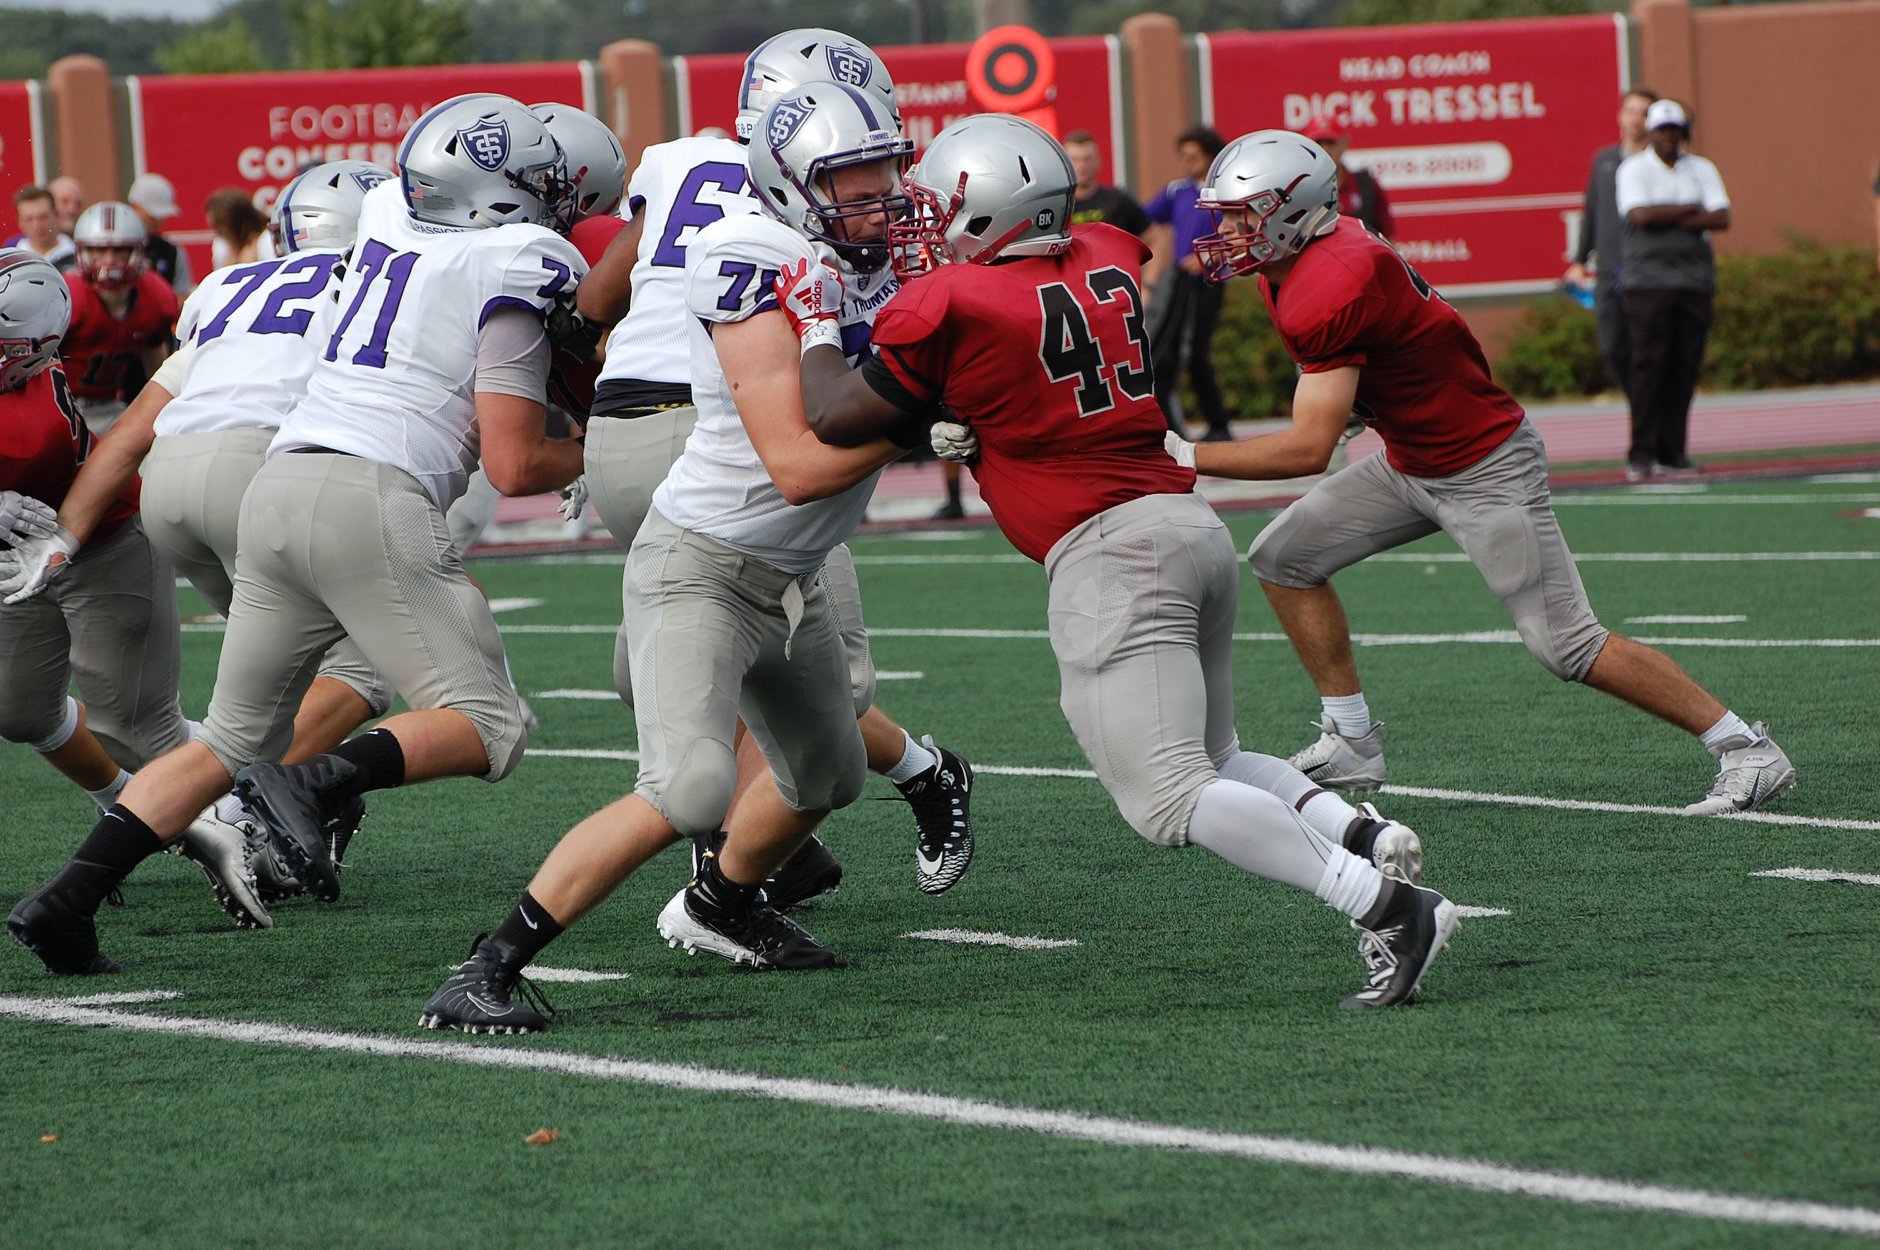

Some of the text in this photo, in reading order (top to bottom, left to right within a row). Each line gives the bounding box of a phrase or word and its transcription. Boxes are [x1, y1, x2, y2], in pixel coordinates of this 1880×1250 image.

[1339, 50, 1491, 82] HEAD COACH
[896, 80, 968, 107] STANT
[1283, 81, 1545, 131] DICK TRESSEL
[268, 102, 434, 141] FOOTBA
[1038, 212, 1053, 226] BK
[1395, 239, 1473, 264] OTBALL
[197, 252, 342, 349] 72
[324, 237, 422, 370] 71
[812, 280, 823, 315] adidas
[854, 278, 900, 315] THOMAS
[1036, 264, 1155, 418] 43
